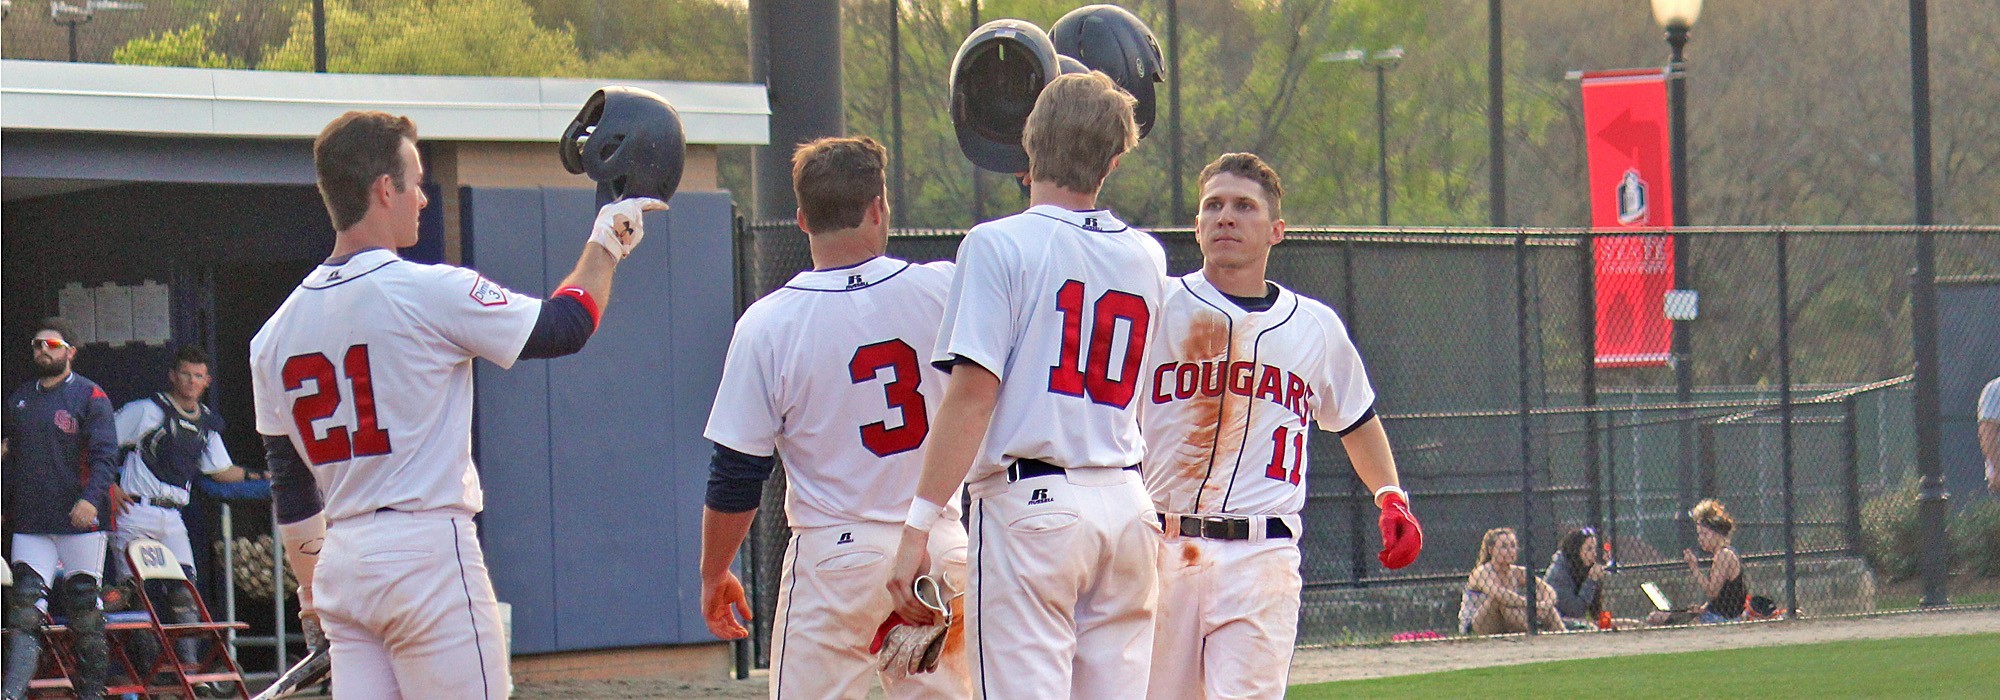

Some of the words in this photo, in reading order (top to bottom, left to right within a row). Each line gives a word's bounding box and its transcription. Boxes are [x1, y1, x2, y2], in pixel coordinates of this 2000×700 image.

[488, 290, 501, 299] 3
[1048, 279, 1149, 409] 10
[282, 344, 392, 466] 21
[849, 338, 929, 457] 3
[1152, 361, 1314, 427] COUGARS
[1265, 425, 1303, 487] 11
[1027, 497, 1054, 505] RUSSELL
[140, 545, 165, 566] CSU
